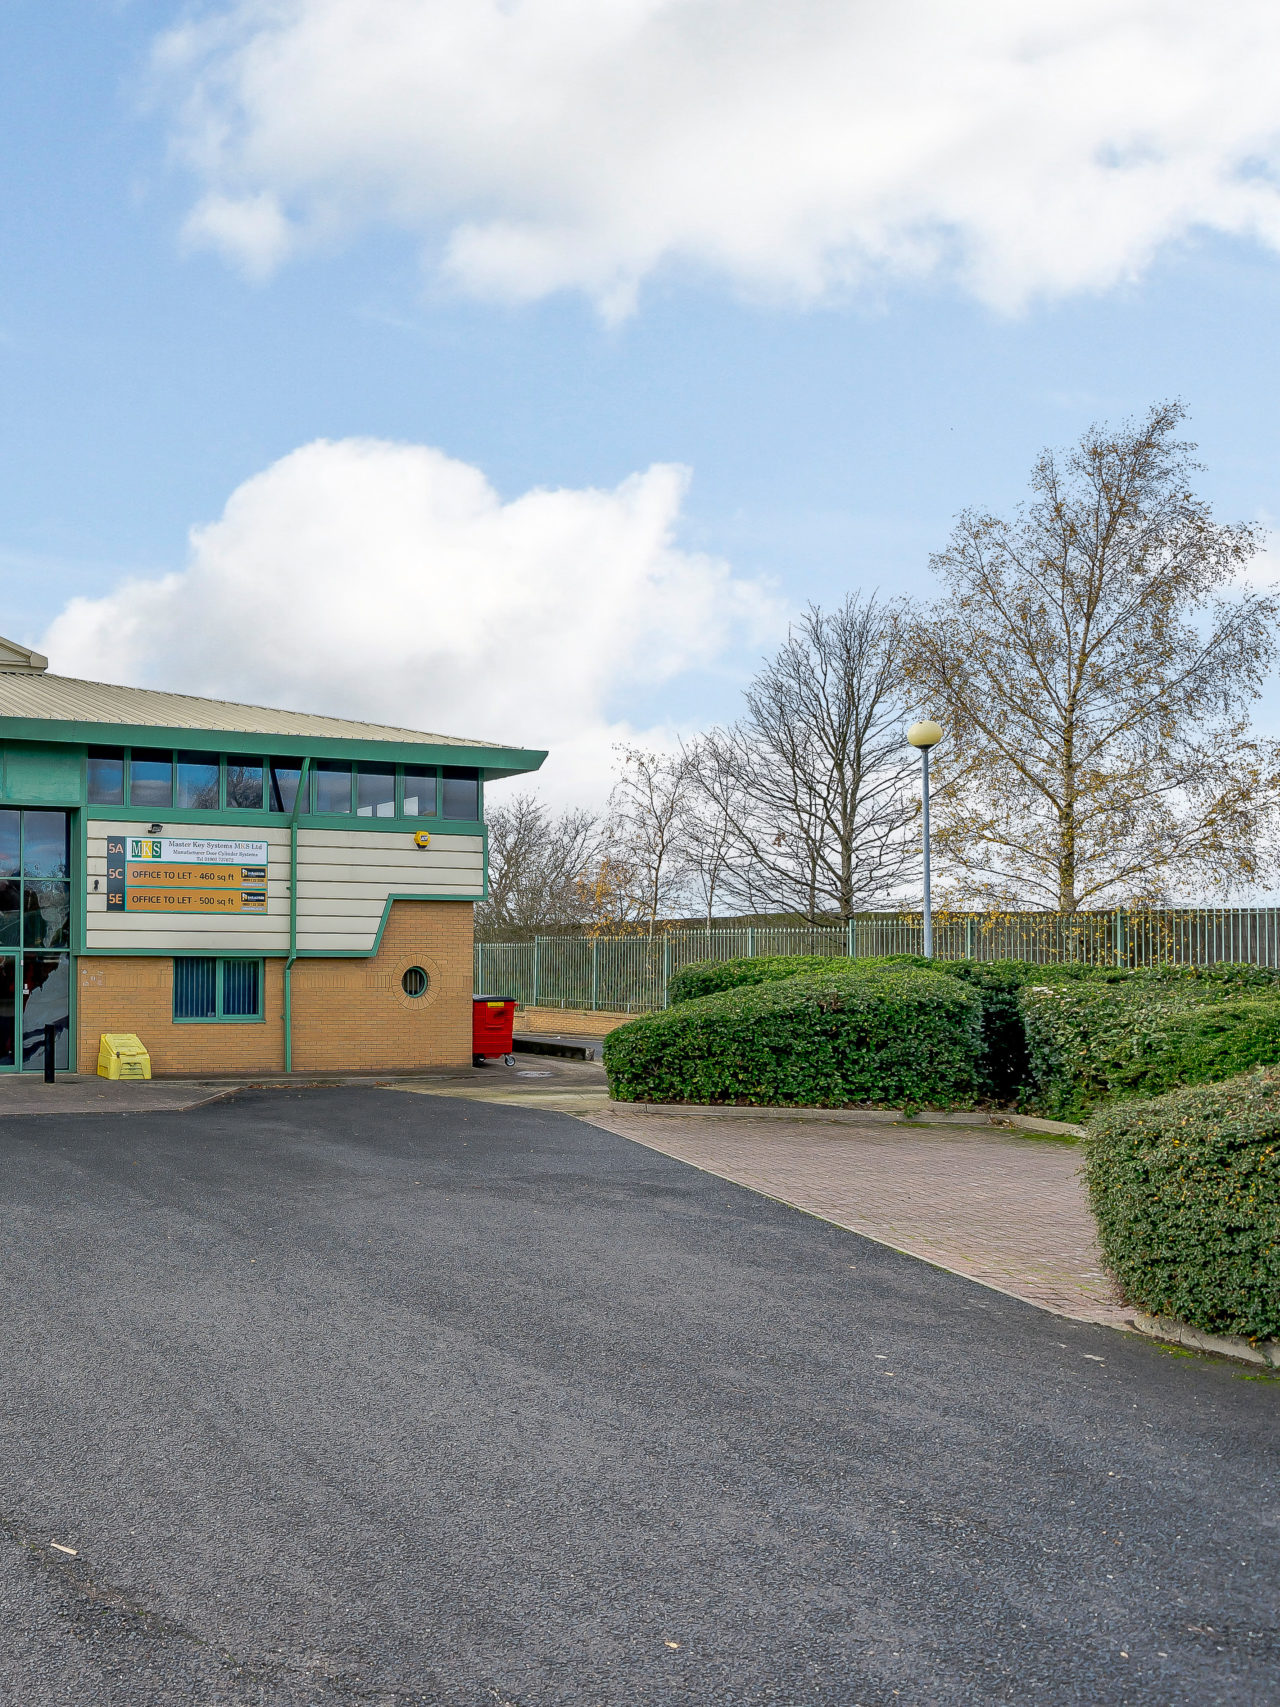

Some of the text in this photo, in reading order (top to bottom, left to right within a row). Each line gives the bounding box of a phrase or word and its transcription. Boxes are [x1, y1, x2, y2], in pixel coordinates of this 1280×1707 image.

[108, 843, 124, 853] 5A
[132, 841, 161, 856] MKS
[168, 840, 191, 848] Master
[192, 841, 205, 849] Key
[206, 842, 233, 850] Systems
[108, 868, 123, 879] 5C
[132, 870, 161, 879] OFFICE
[163, 871, 175, 879] TO
[177, 871, 192, 880] LET
[199, 872, 215, 880] 460
[216, 874, 226, 882] sq
[108, 893, 123, 904] 5E
[132, 895, 161, 903] OFFICE
[163, 896, 175, 904] TO
[177, 896, 192, 904] LET
[199, 897, 215, 905] 500
[228, 897, 234, 905] ft
